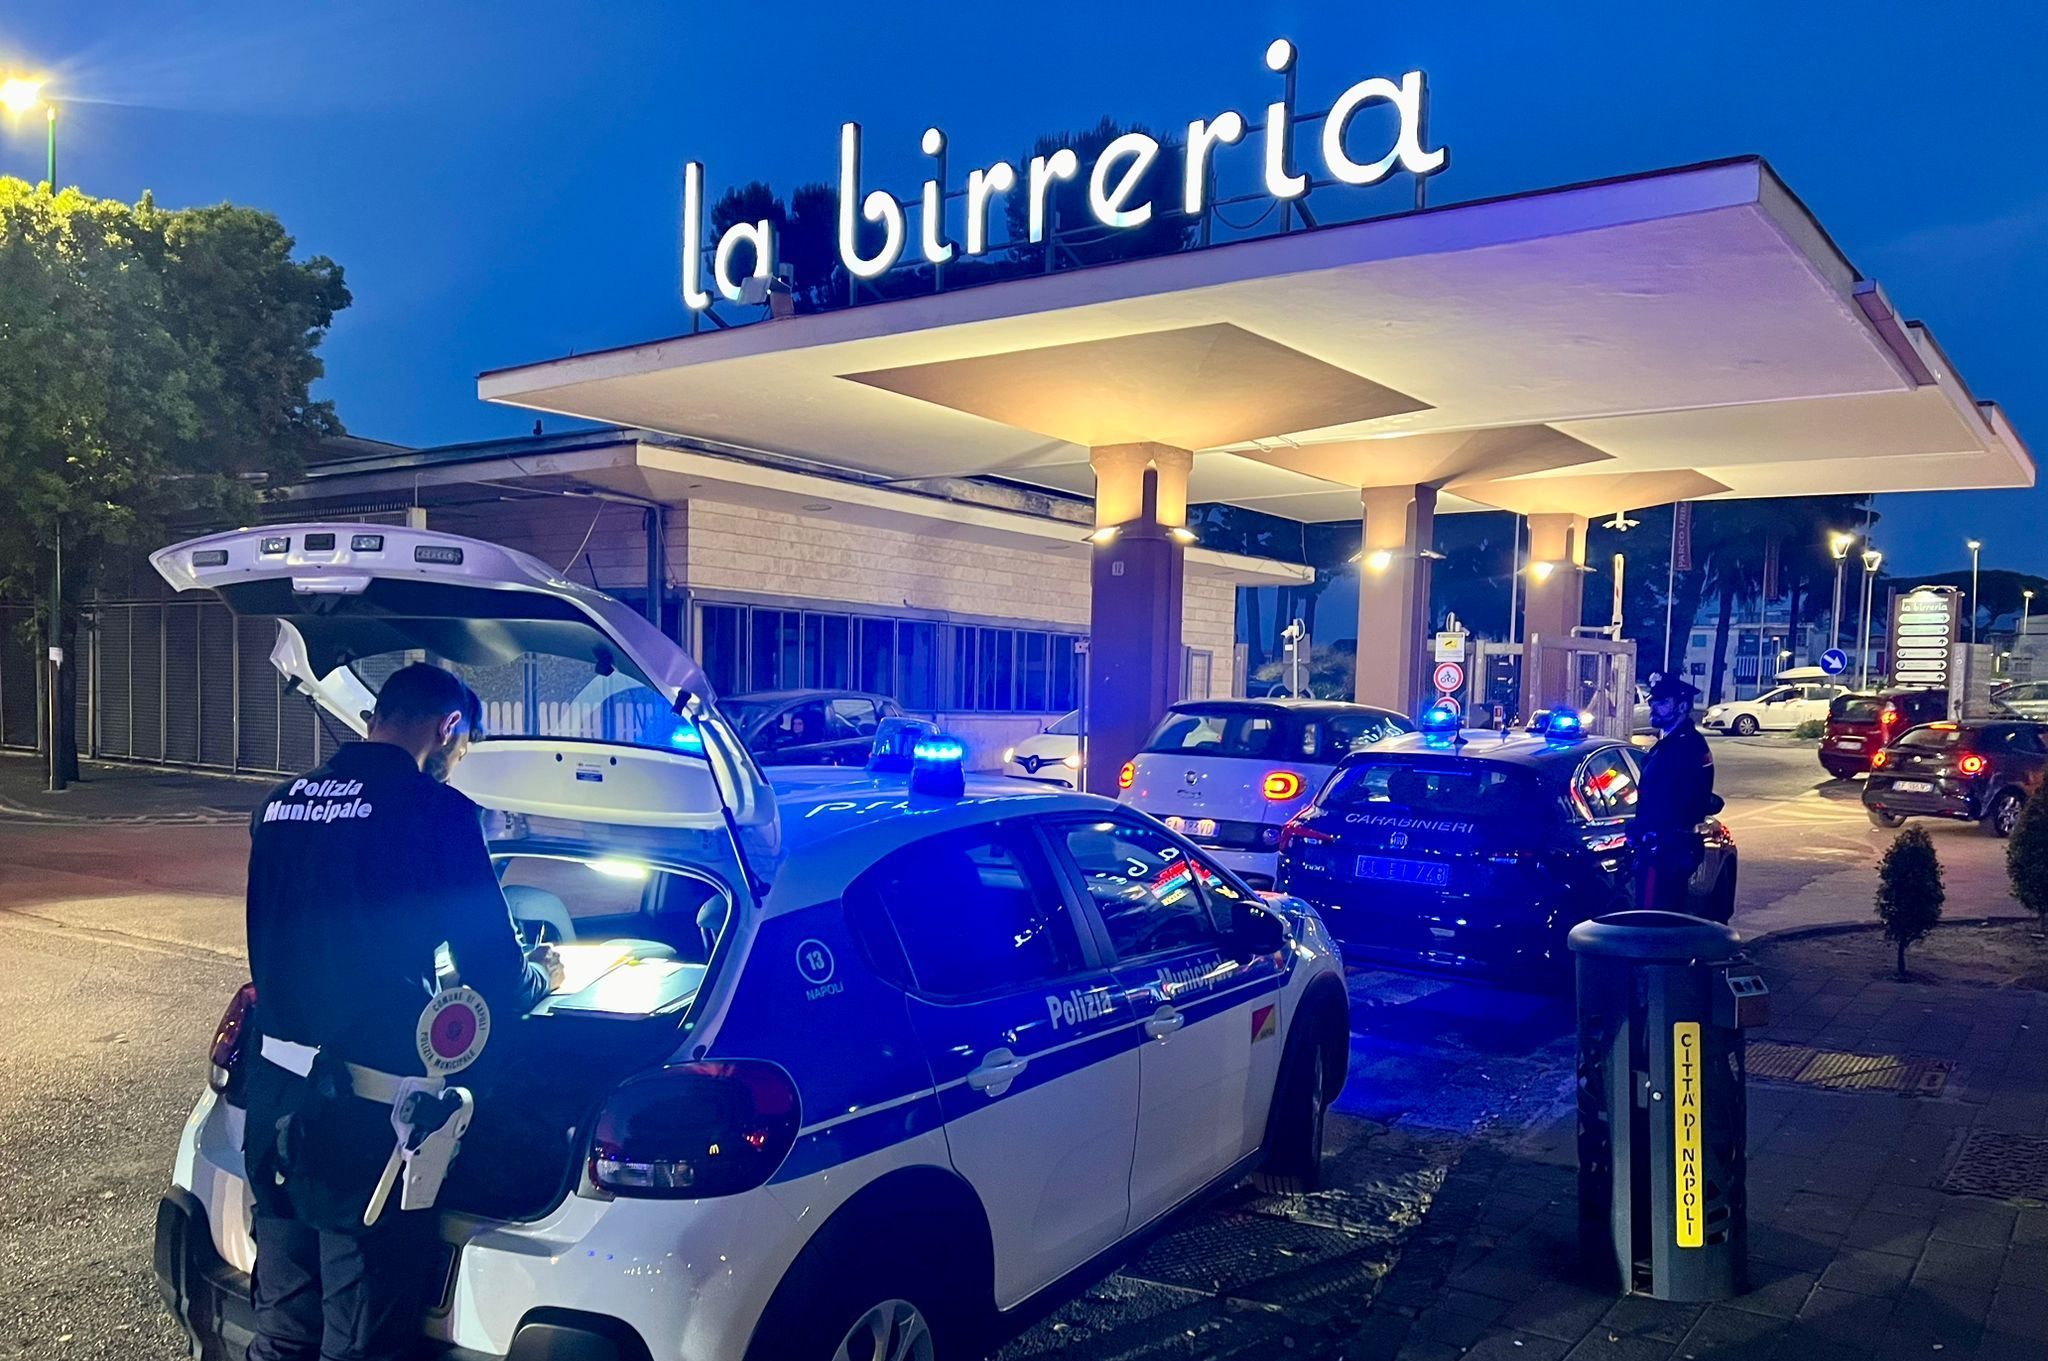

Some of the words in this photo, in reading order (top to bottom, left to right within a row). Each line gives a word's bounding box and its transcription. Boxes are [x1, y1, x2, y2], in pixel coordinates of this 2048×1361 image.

[683, 161, 775, 309] la
[838, 38, 1450, 279] birreria
[1678, 531, 1686, 567] PARCO
[289, 779, 363, 797] Polizia
[263, 798, 372, 823] Municipale
[1345, 813, 1474, 833] CARABINIERI
[806, 950, 825, 970] 13
[806, 981, 844, 1001] NAPOLI
[1045, 985, 1113, 1030] Polizia
[1157, 953, 1234, 997] Municipale
[420, 1031, 434, 1060] POLIZIA
[434, 1049, 475, 1070] MUNICIPALE
[1684, 1113, 1696, 1141] DI
[1683, 1148, 1696, 1236] NAPOLI
